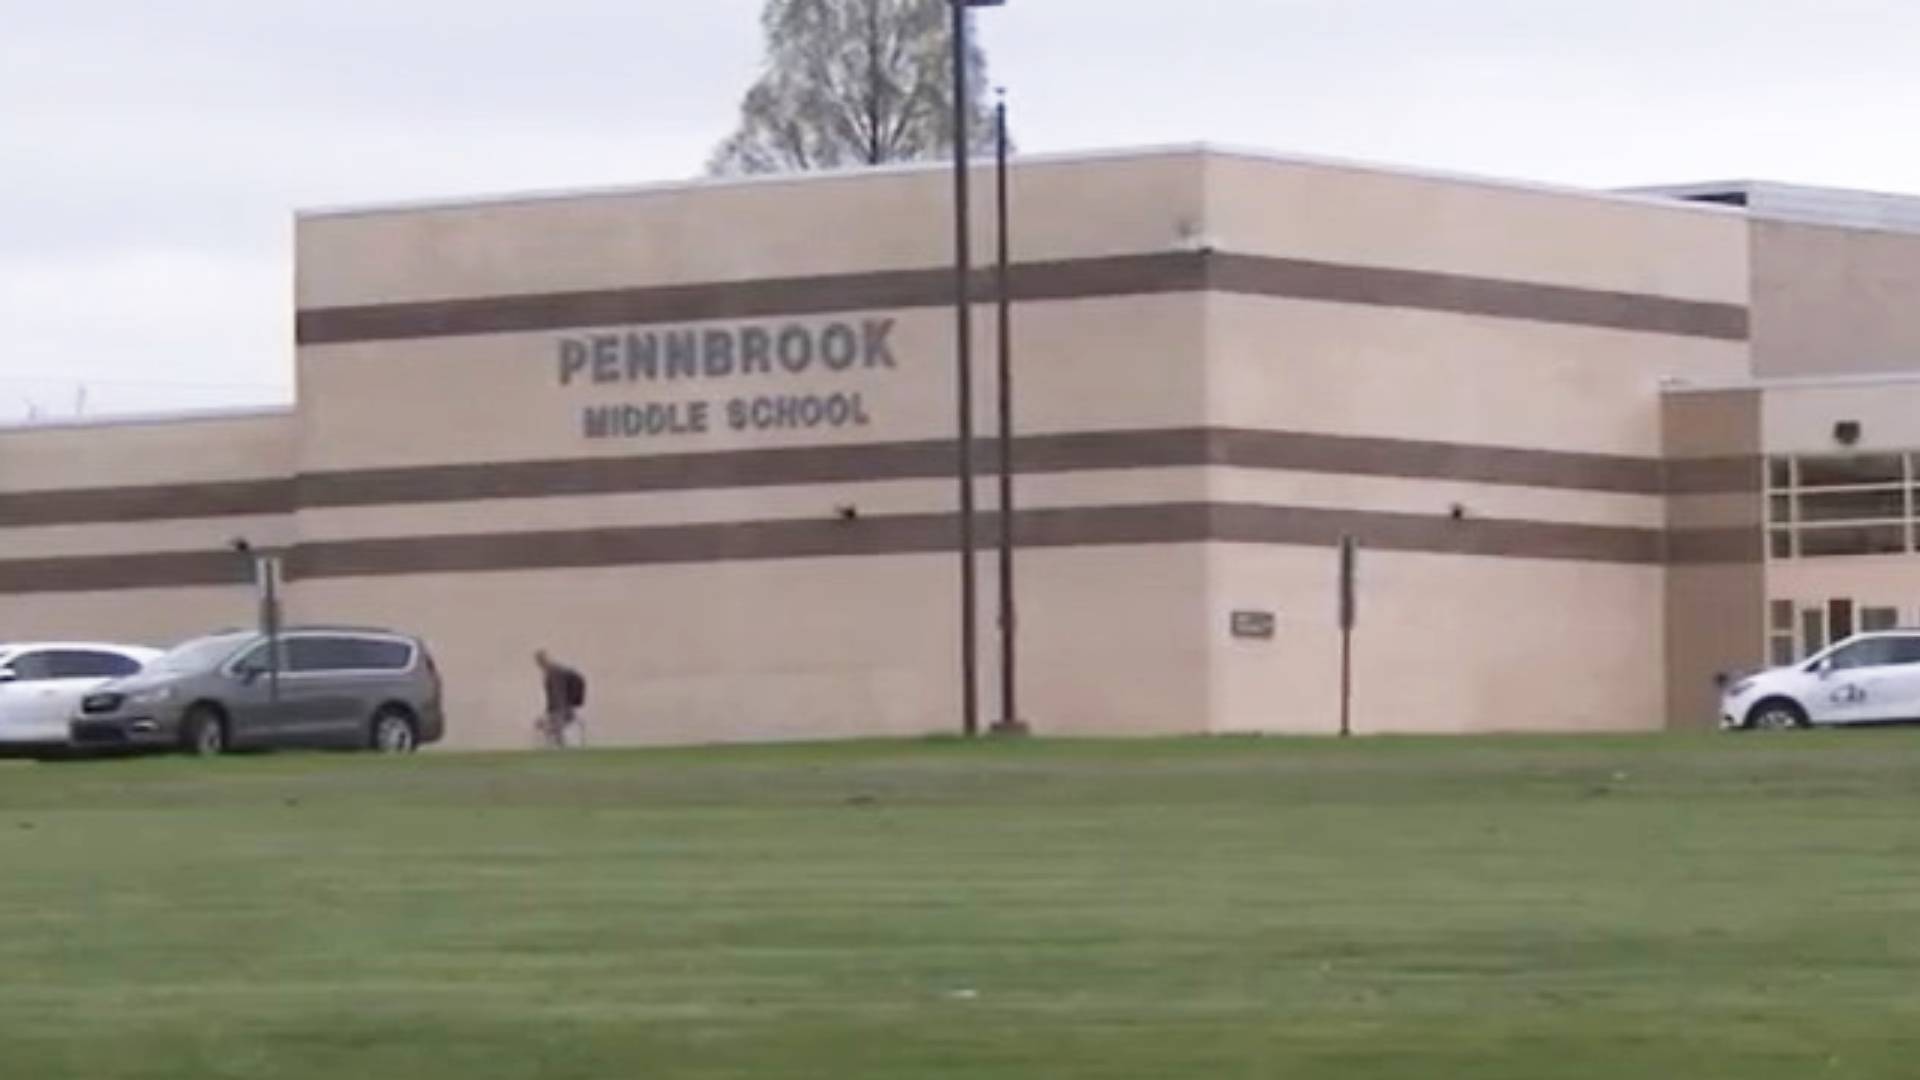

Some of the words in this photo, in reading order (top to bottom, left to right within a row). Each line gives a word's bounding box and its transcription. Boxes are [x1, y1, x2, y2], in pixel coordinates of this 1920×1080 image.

[558, 318, 897, 386] PENNBROOK
[583, 401, 709, 438] MIDDLE
[727, 393, 870, 430] SCHOOL
